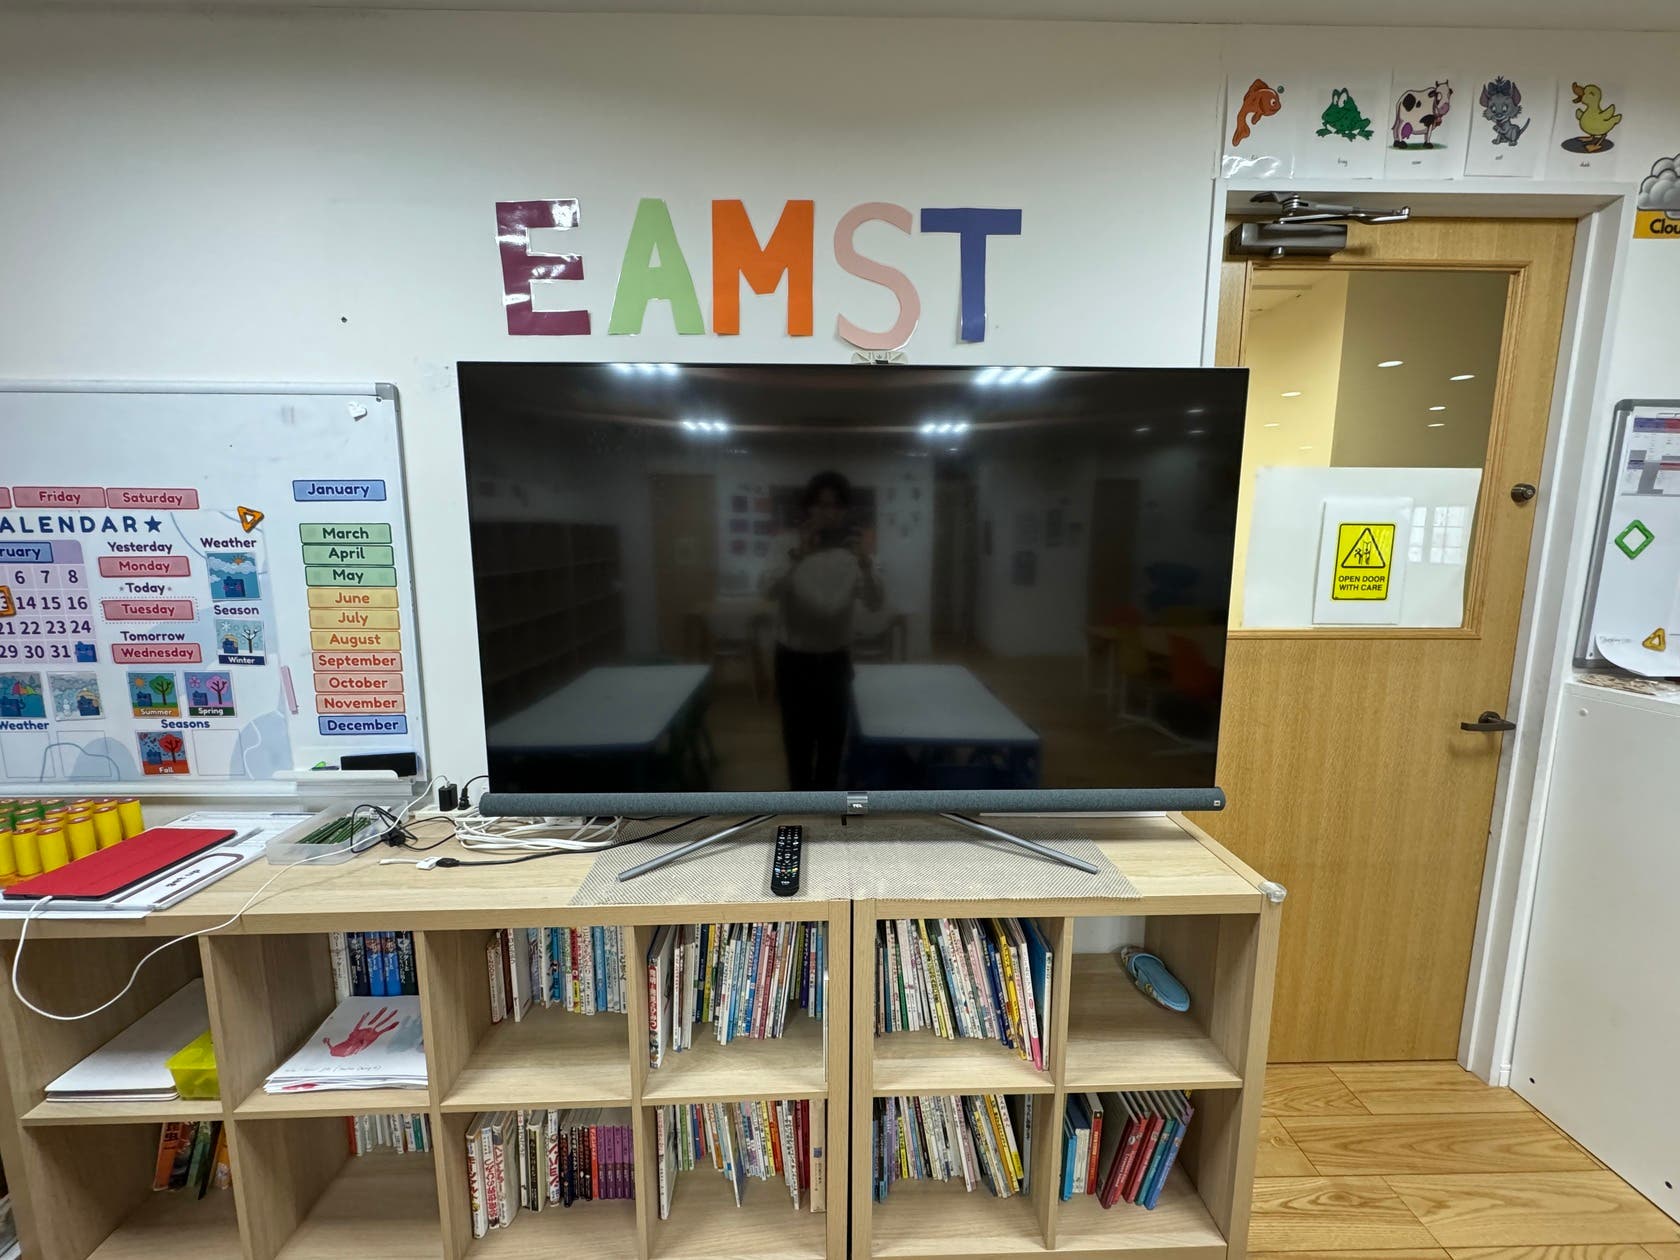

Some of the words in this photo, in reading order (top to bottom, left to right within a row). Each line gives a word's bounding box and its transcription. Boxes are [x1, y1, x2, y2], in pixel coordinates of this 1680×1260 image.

[307, 483, 370, 498] January
[39, 491, 81, 505] Friday
[122, 492, 183, 506] Saturday
[0, 515, 138, 533] ALENDAR
[322, 527, 369, 539] March
[107, 541, 173, 555] Yesterday
[201, 537, 257, 548] Weather
[328, 548, 365, 561] April
[119, 561, 170, 574] Monday
[15, 570, 26, 584] 6
[40, 570, 50, 584] 7
[68, 569, 79, 584] 8
[333, 570, 364, 583] May
[125, 582, 165, 595] Today
[16, 596, 37, 610] 14
[41, 596, 62, 610] 15
[67, 596, 88, 610] 16
[335, 593, 370, 604] June
[121, 604, 176, 617] Tuesday
[214, 605, 259, 615] Season
[338, 612, 368, 626] July
[20, 621, 41, 635] 22
[46, 621, 67, 634] 23
[71, 620, 92, 634] 24
[120, 631, 185, 642] Tomorrow
[329, 634, 381, 648] August
[0, 645, 18, 658] 29
[24, 645, 45, 659] 30
[51, 645, 71, 658] 31
[120, 647, 194, 660] Wednesday
[227, 655, 256, 665] Winter
[318, 655, 396, 669] September
[329, 677, 389, 689] October
[324, 697, 397, 709] November
[140, 708, 172, 716] Summer
[198, 706, 224, 716] Spring
[161, 719, 211, 729] Seasons
[327, 719, 399, 731] December
